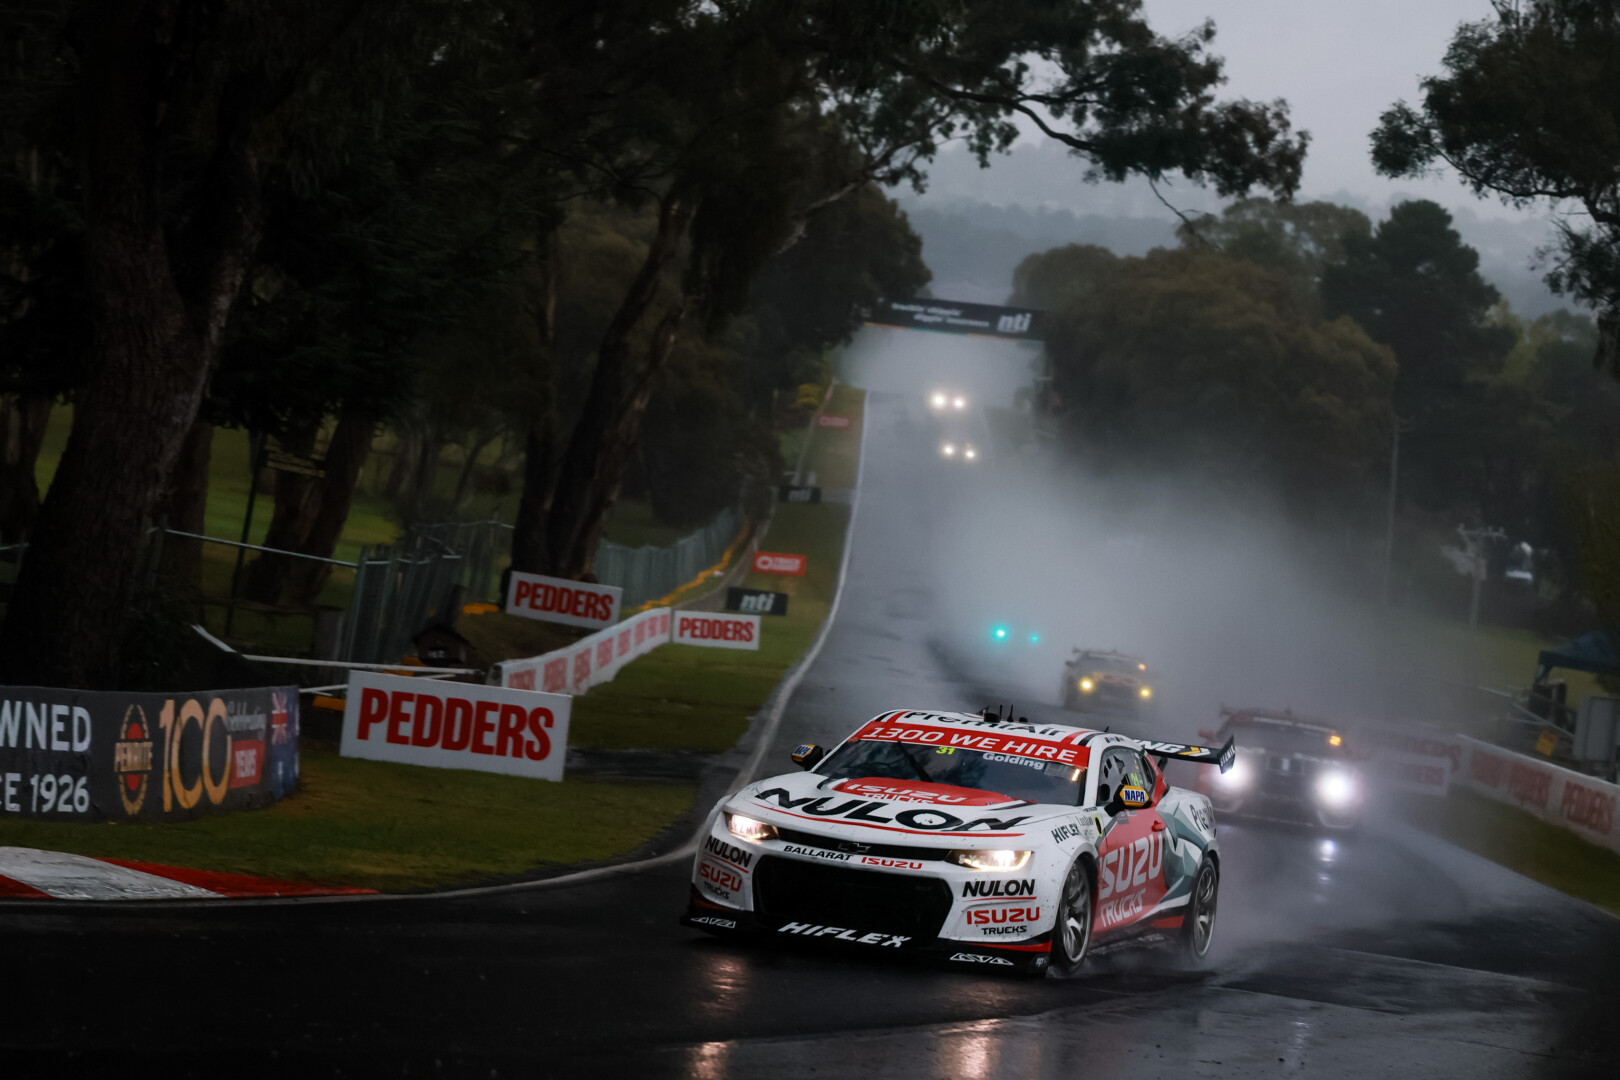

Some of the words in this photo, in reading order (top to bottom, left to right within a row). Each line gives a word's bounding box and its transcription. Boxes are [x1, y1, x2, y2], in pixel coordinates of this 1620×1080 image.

[997, 312, 1032, 332] nti
[514, 580, 613, 621] PEDDERS
[741, 593, 775, 612] nti
[679, 617, 753, 642] PEDDERS
[357, 687, 553, 760] PEDDERS
[904, 711, 1066, 736] PremiAir
[159, 697, 232, 812] 100
[863, 727, 944, 742] 1300
[949, 733, 1000, 749] WE
[1002, 740, 1078, 762] HIRE
[936, 746, 956, 755] 31
[1133, 739, 1186, 754] NG
[982, 752, 1045, 770] Golding
[0, 772, 21, 812] E
[30, 773, 90, 813] 1926
[847, 784, 967, 803] ISUZU
[863, 792, 934, 804] TRUCKS
[1124, 790, 1145, 802] NAPA
[755, 788, 1033, 831] NULON
[705, 835, 752, 868] NULON
[783, 845, 854, 861] BALLARAT
[861, 857, 922, 869] ISUZU
[704, 881, 730, 899] TRUCKS
[962, 879, 1035, 897] NULON
[967, 907, 1040, 925] ISUZU
[1100, 888, 1146, 927] TRUCKS
[777, 921, 912, 948] HIFLEX
[982, 925, 1027, 935] TRUCKS
